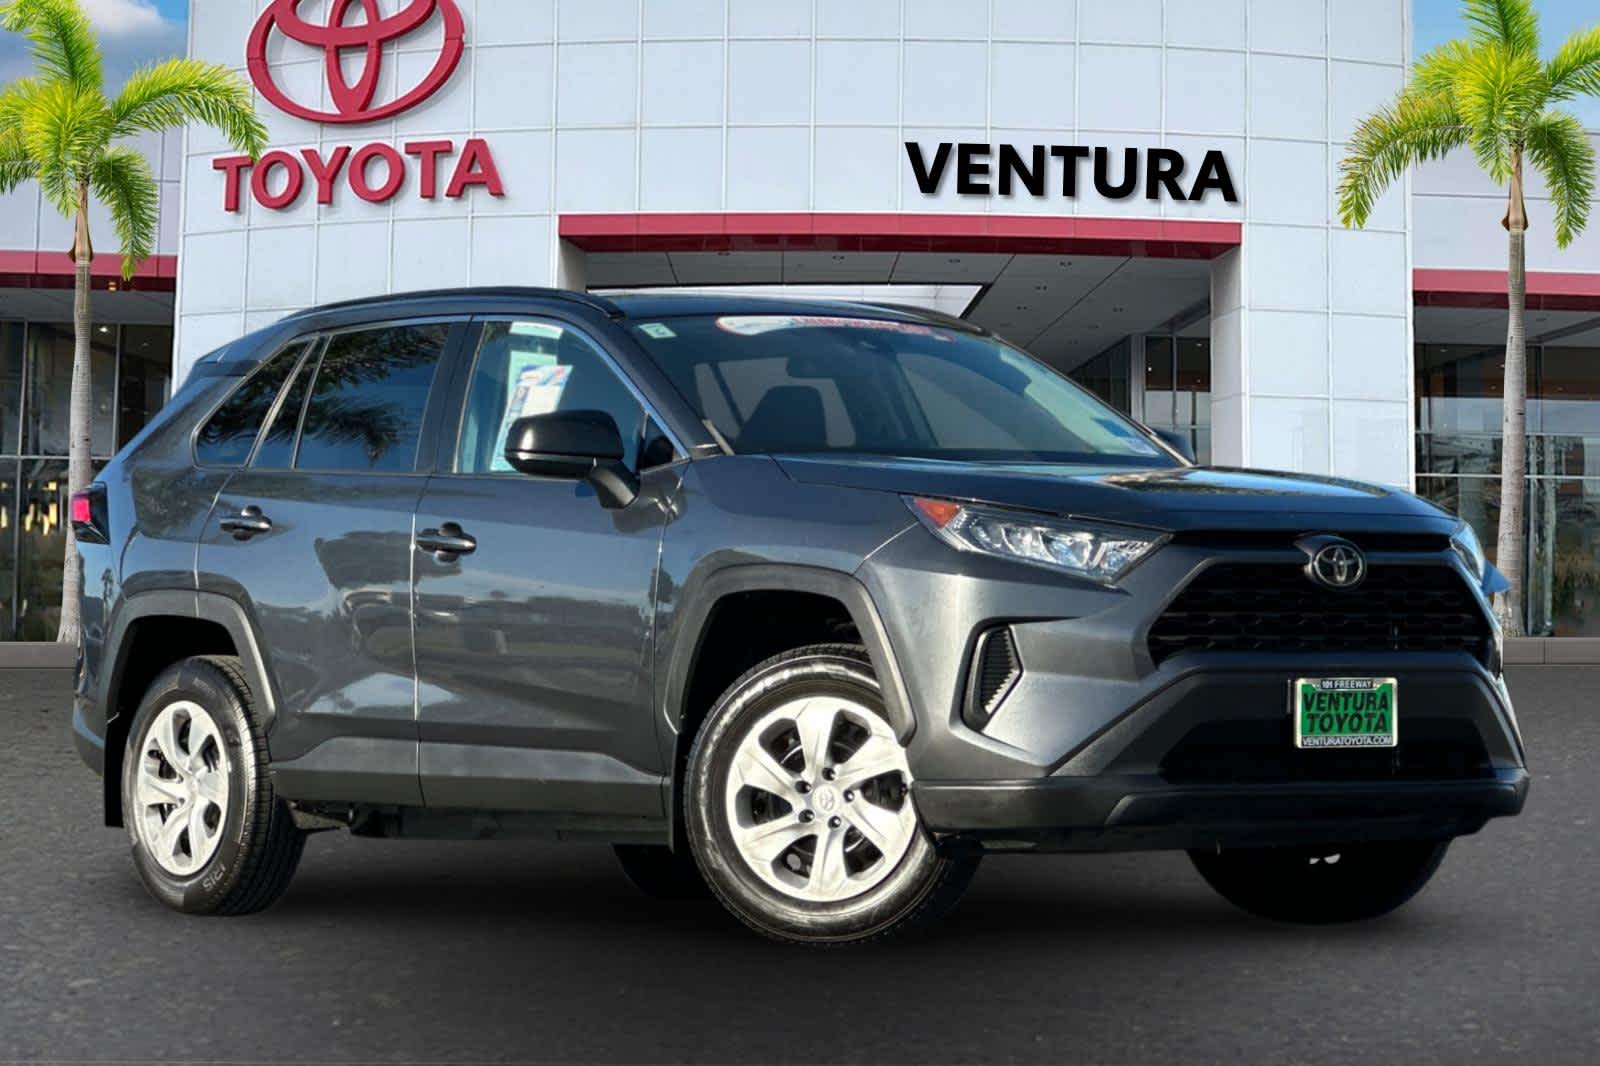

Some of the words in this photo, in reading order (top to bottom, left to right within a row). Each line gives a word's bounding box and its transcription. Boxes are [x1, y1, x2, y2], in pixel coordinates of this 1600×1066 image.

[213, 138, 505, 212] TOYOTA
[904, 142, 1238, 203] VENTURA
[1334, 680, 1372, 689] FREEWAY
[1303, 692, 1388, 711] VENTURA
[1306, 713, 1388, 733] TOYOTA
[1302, 736, 1392, 746] VENTURATOYOTA.COM
